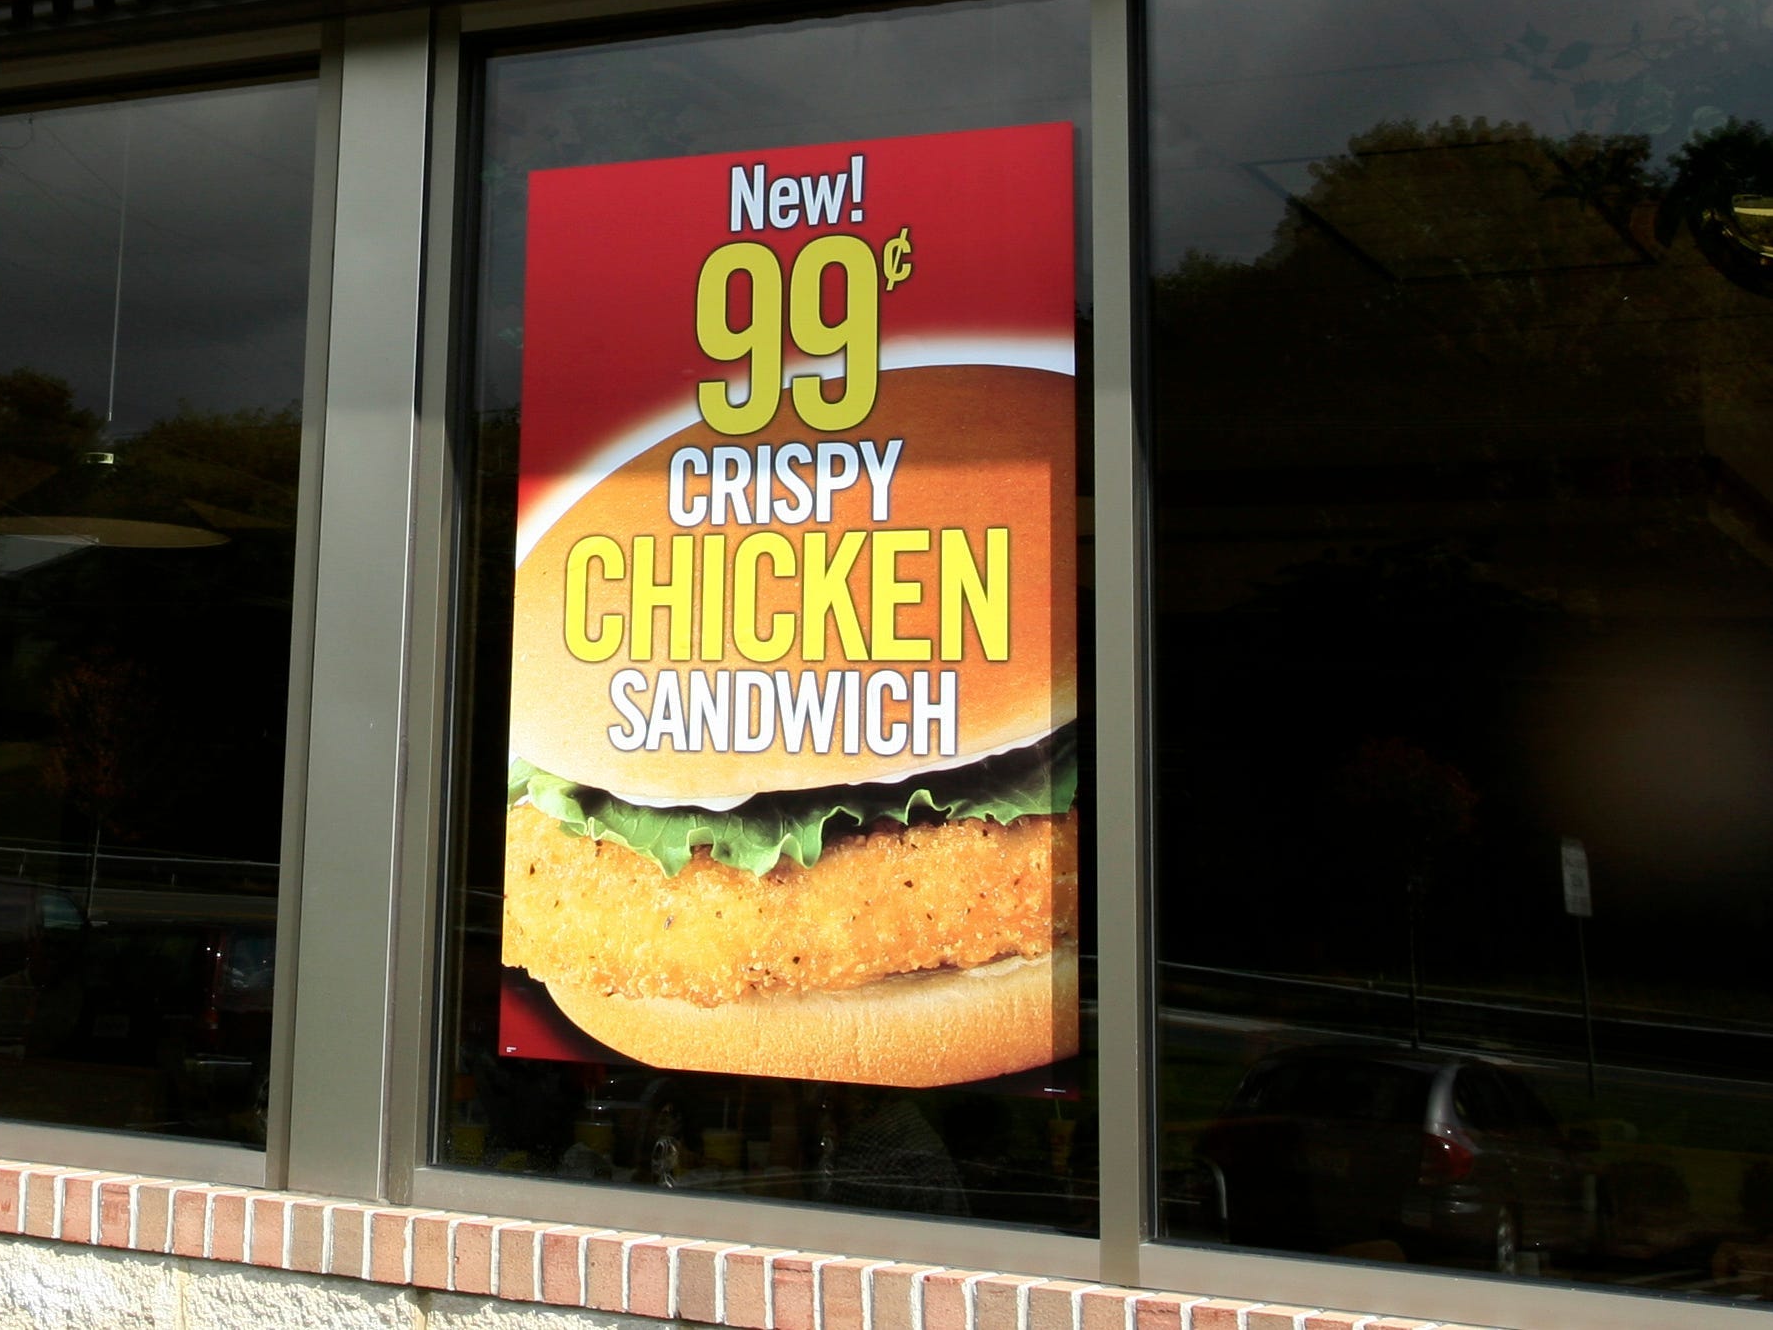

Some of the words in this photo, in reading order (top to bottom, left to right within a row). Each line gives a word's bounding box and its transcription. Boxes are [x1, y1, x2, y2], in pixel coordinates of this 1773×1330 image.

[729, 154, 866, 234] New!
[668, 439, 904, 527] CRISPY
[563, 526, 1010, 664] CHICKEN
[607, 668, 958, 757] SANDWICH
